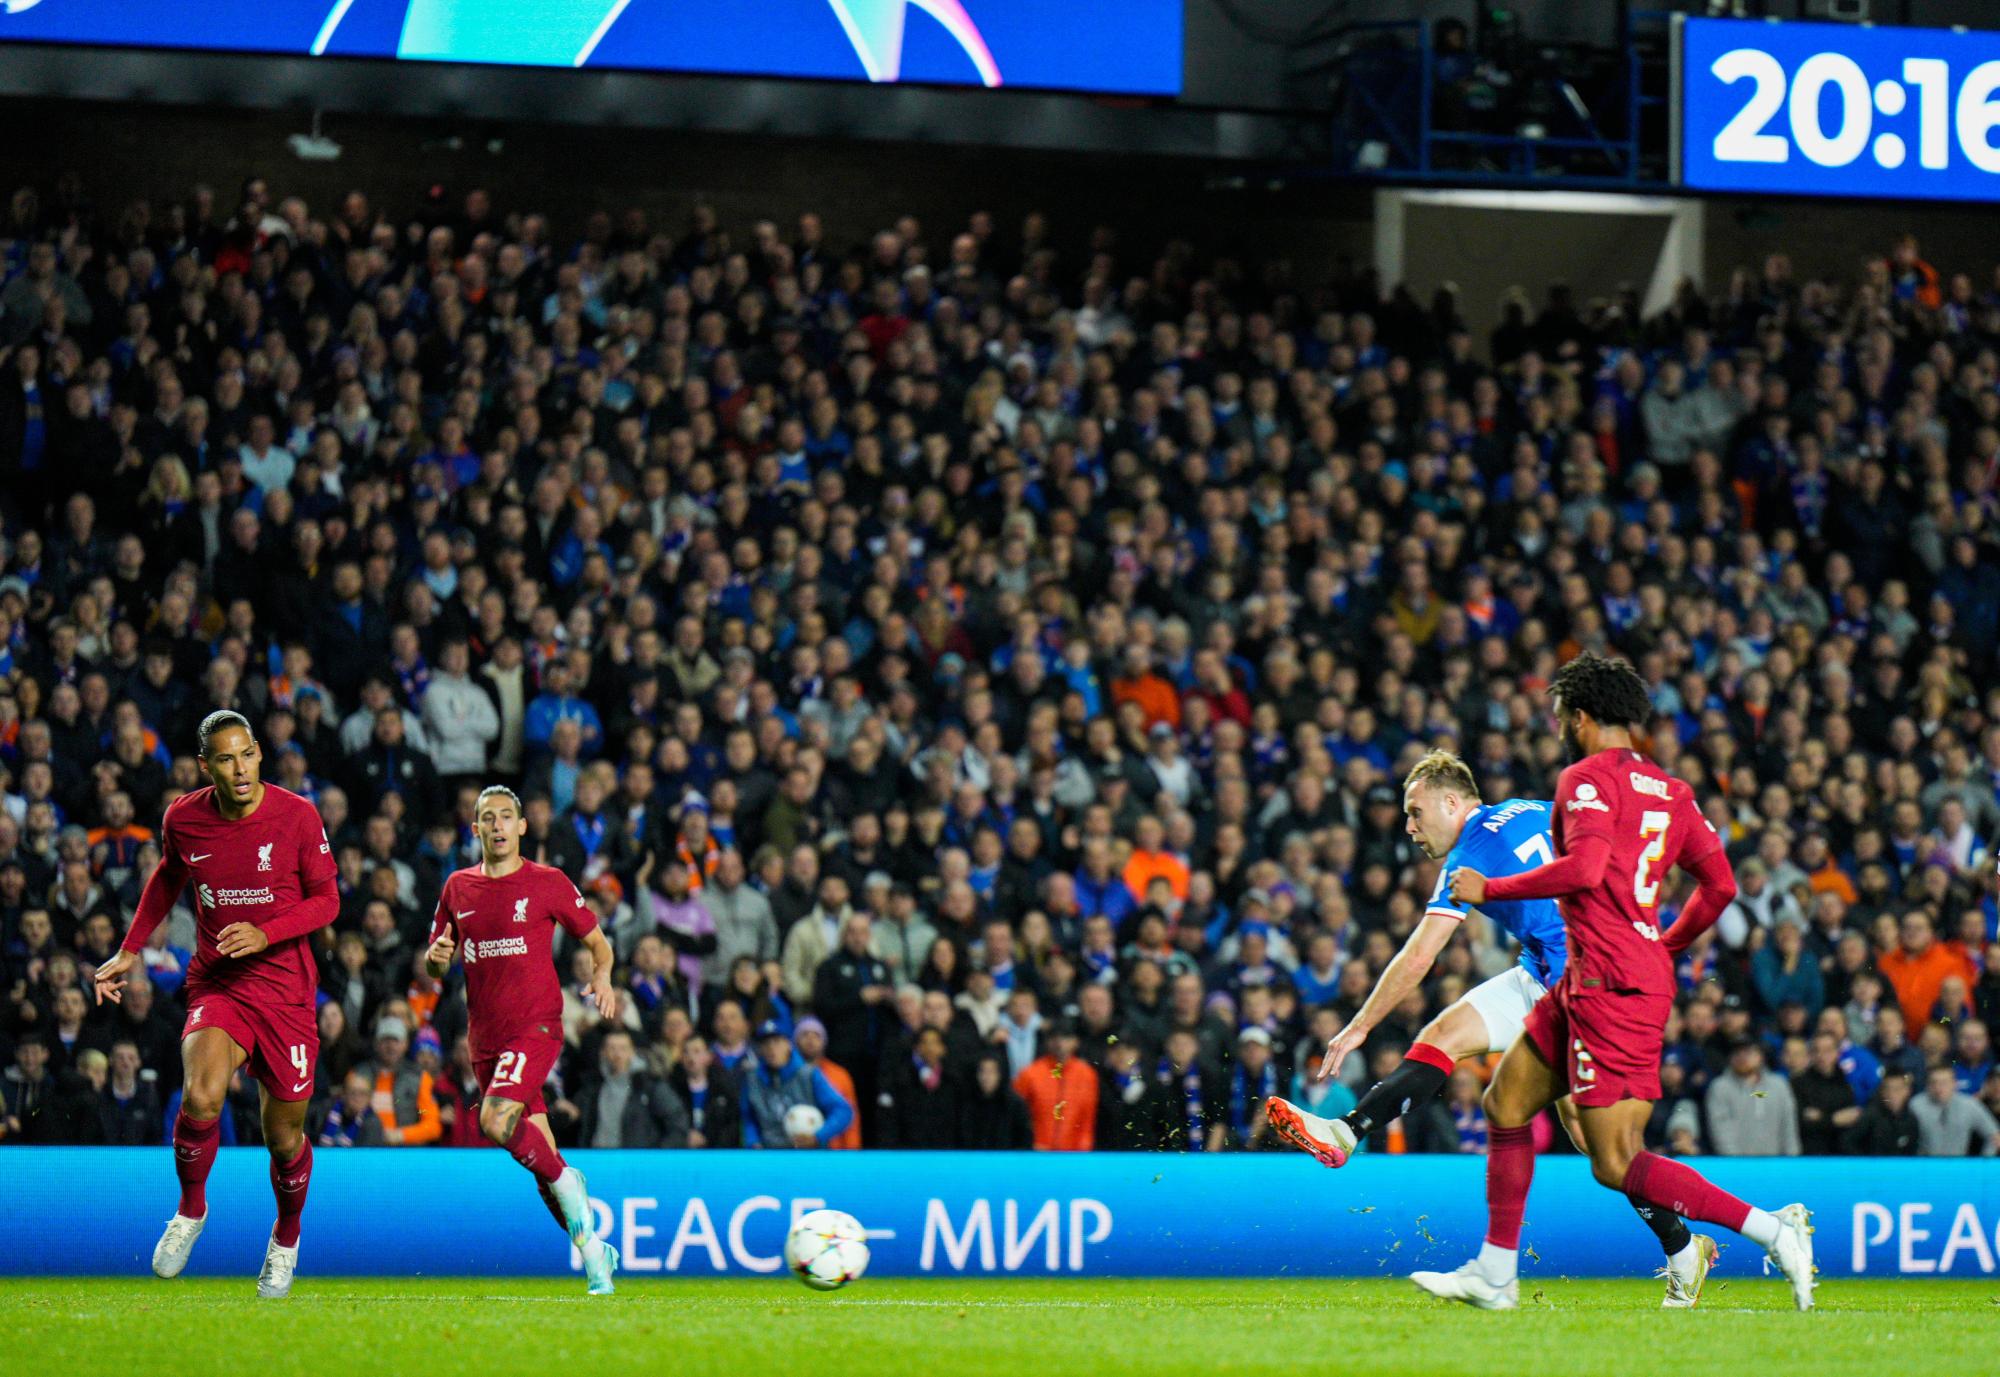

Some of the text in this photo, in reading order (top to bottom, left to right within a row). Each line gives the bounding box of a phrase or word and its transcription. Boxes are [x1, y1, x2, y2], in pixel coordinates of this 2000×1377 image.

[1634, 810, 1671, 908] 2
[216, 886, 270, 898] standard
[218, 893, 274, 906] chartered
[478, 935, 525, 950] standard
[478, 944, 528, 959] chartered
[290, 1043, 308, 1079] 4
[494, 1051, 527, 1085] 21
[919, 1198, 1113, 1271] МИР
[1852, 1200, 2000, 1273] PEA
